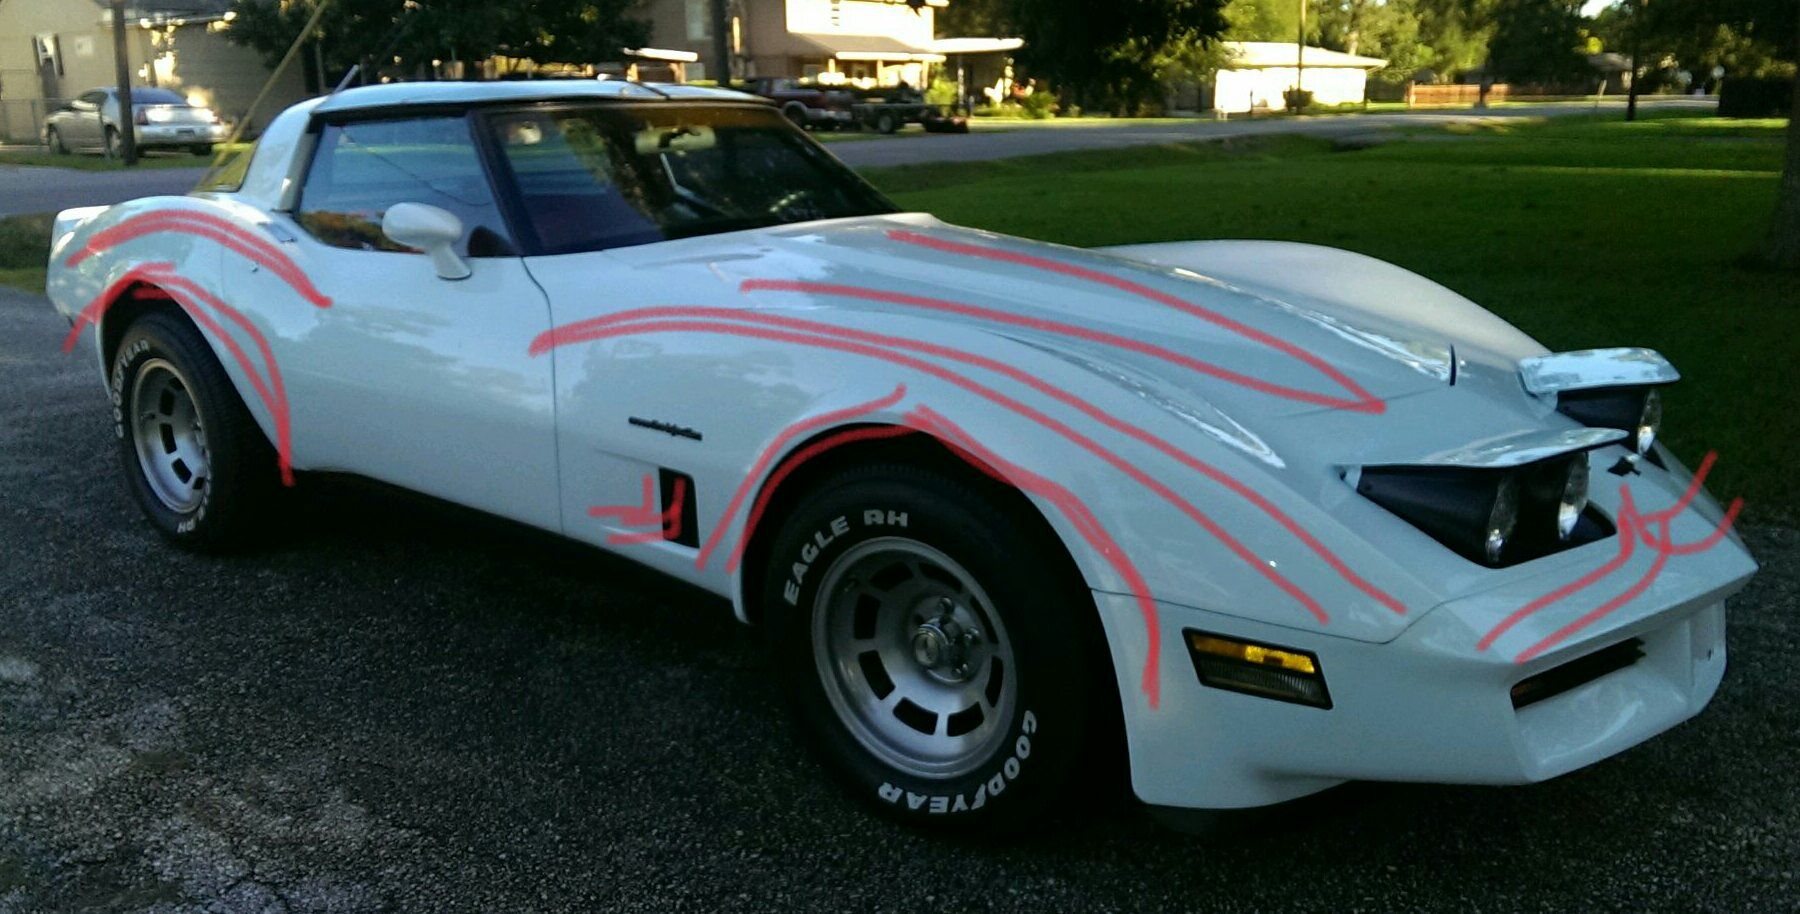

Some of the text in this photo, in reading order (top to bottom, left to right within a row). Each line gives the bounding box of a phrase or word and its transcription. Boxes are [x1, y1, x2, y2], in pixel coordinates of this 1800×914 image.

[113, 339, 149, 438] GOODYEAR
[784, 510, 908, 605] EAGLE RH
[878, 710, 1037, 812] GOODYEAR
